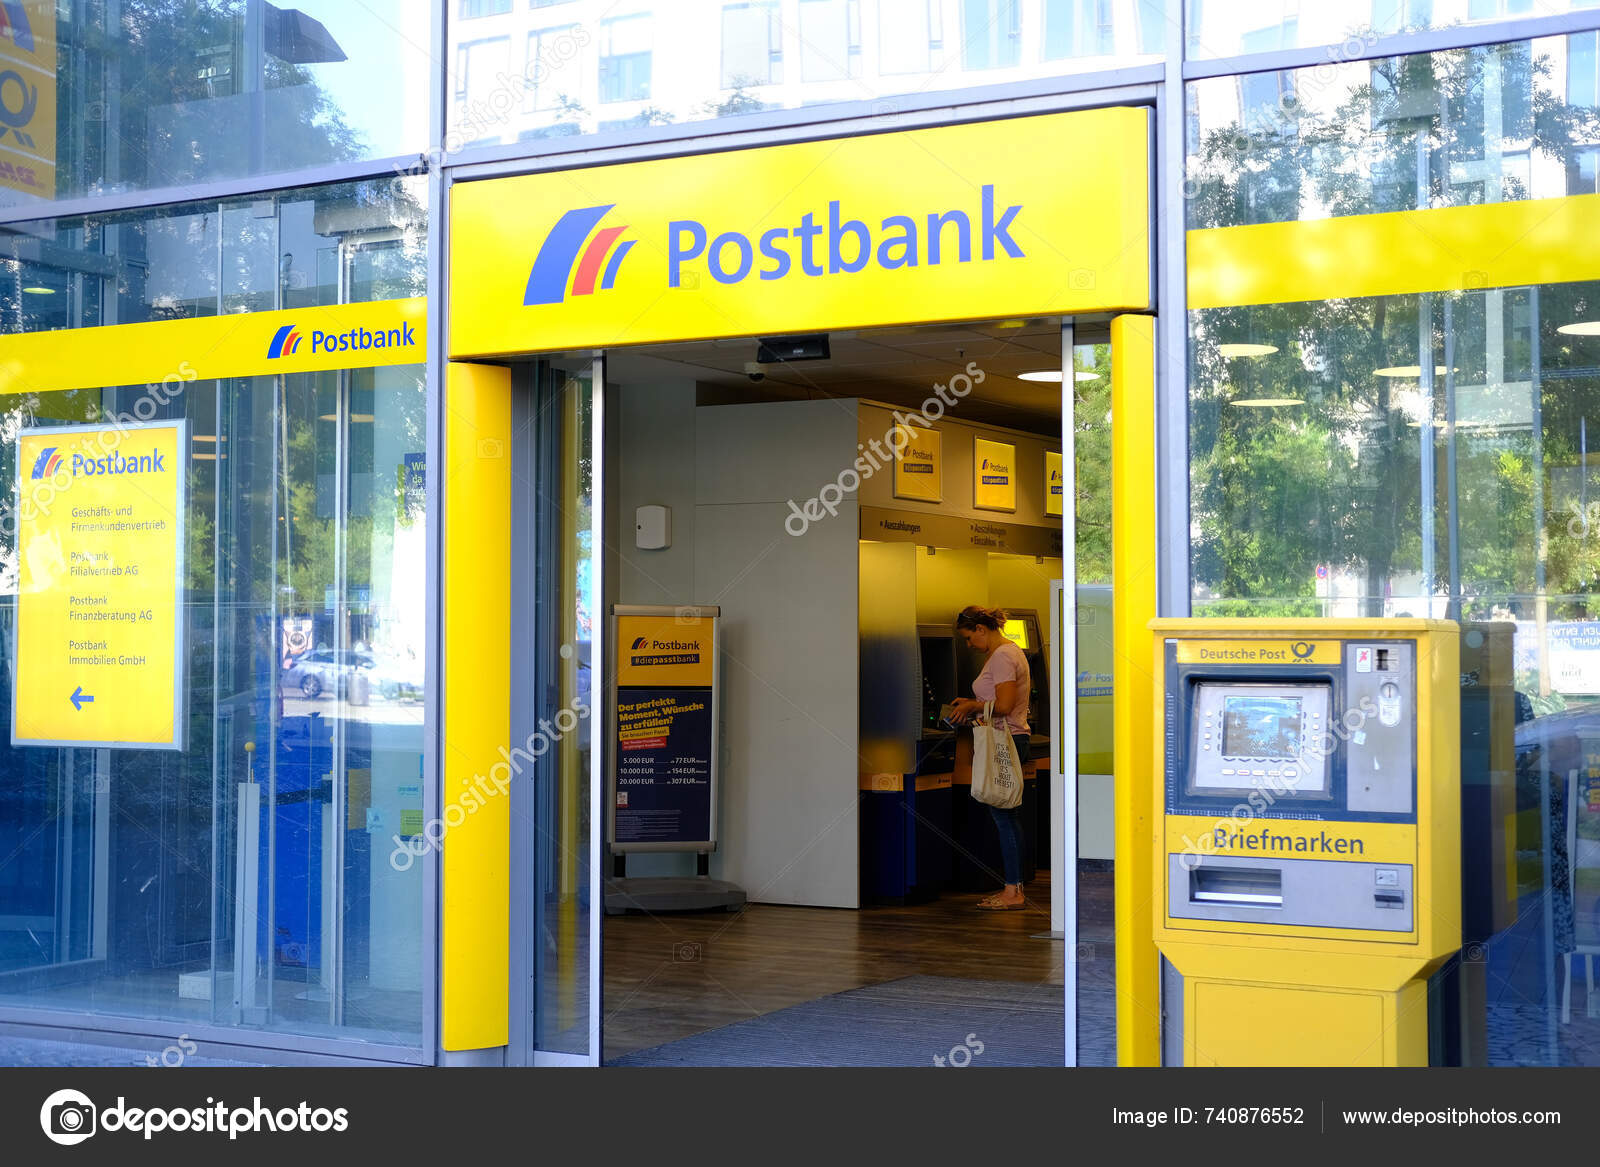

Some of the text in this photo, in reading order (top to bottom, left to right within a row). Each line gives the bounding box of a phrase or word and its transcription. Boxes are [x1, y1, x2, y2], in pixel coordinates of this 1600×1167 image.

[669, 184, 1026, 288] Postbank
[312, 321, 415, 353] Postbank
[73, 448, 165, 476] Postbank
[72, 505, 132, 518] Geschäfts- und
[72, 520, 166, 532] Firmenkundenvertrieb
[71, 565, 139, 576] Filialvertrieb AG
[70, 595, 107, 606] Postbank
[69, 610, 153, 622] Finanzberatung AG
[69, 640, 107, 650] Postbank
[653, 640, 700, 650] Postbank
[69, 655, 146, 665] Immobilien GmbH
[1200, 648, 1286, 660] Deutsche Post
[618, 698, 676, 712] Der perfekte
[619, 702, 704, 721] Moment, Wünsche
[620, 716, 674, 731] zu erfüllen?
[672, 777, 683, 785] 307
[1213, 829, 1364, 855] Briefmarken
